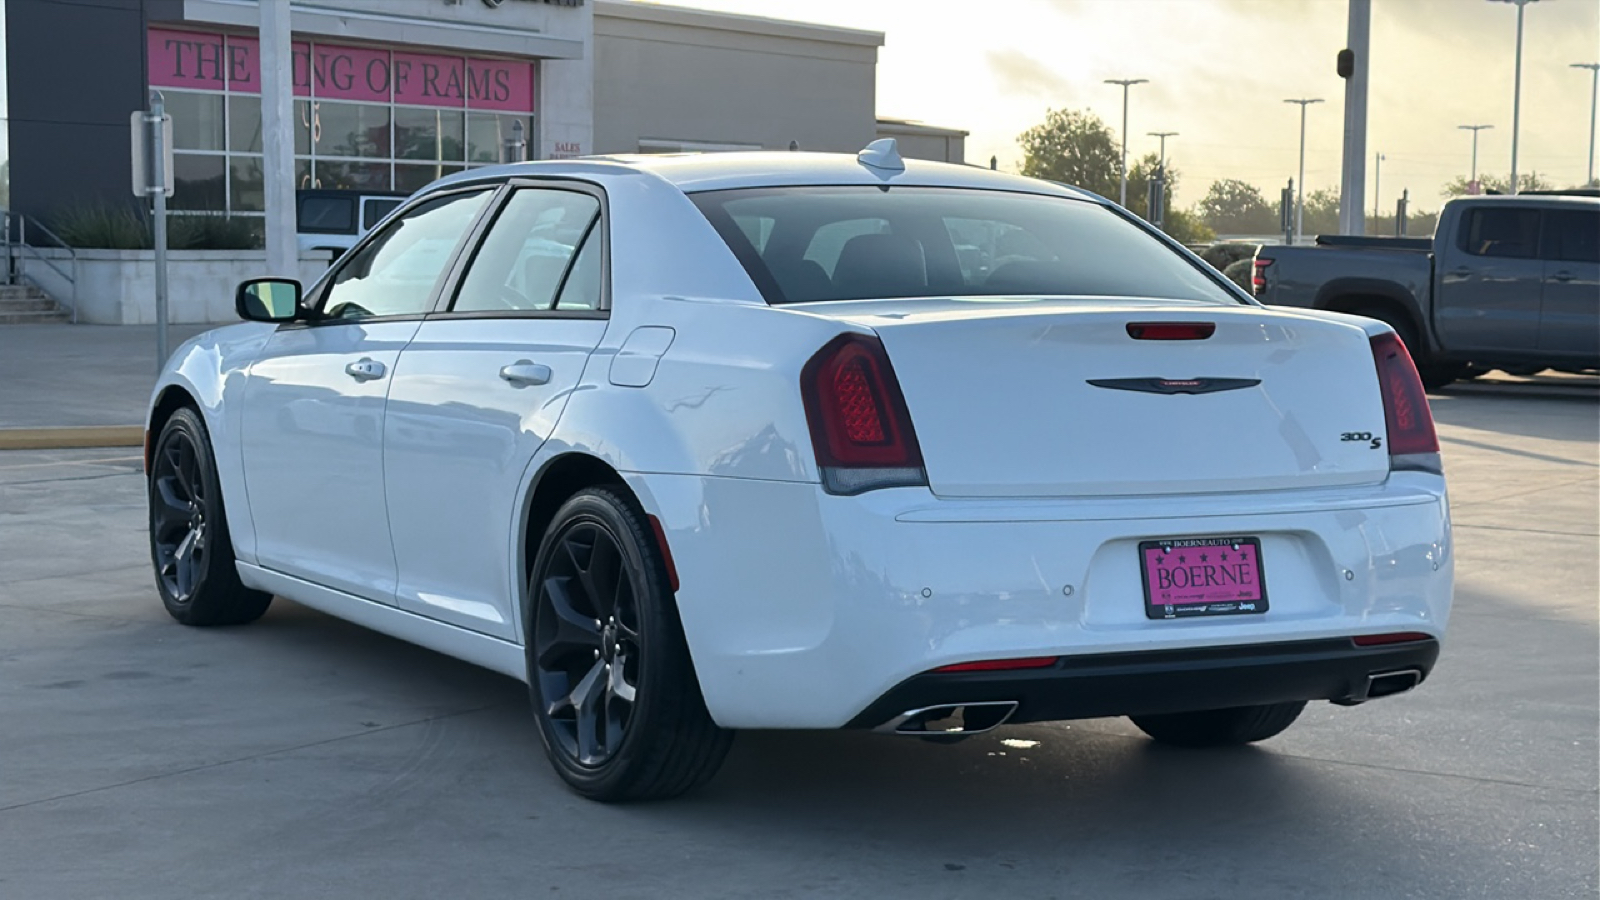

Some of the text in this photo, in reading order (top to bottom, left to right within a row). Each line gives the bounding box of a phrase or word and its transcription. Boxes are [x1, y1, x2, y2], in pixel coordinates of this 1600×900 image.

[165, 39, 510, 102] THE ING OF RAMS
[1157, 563, 1252, 590] BOERNE
